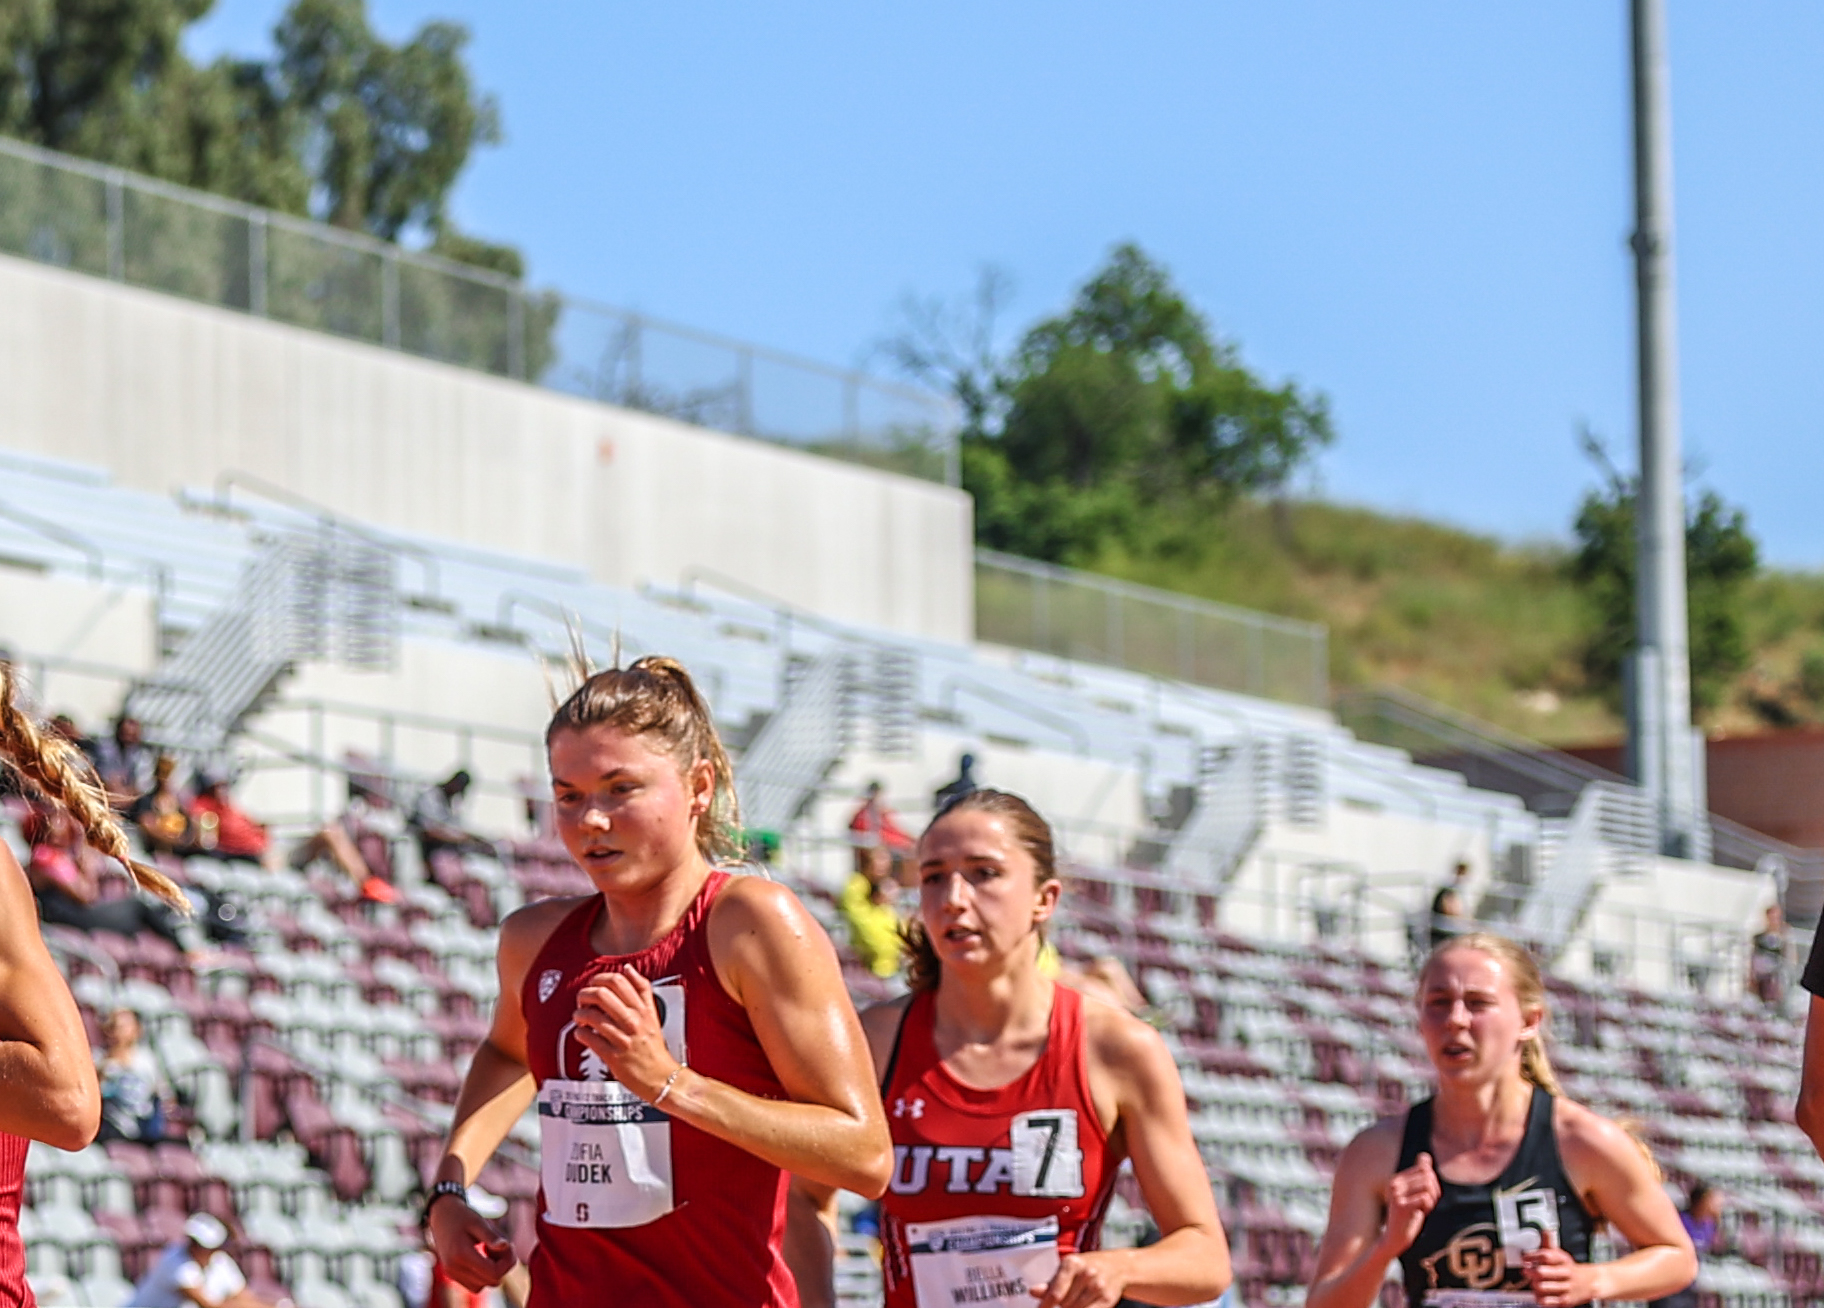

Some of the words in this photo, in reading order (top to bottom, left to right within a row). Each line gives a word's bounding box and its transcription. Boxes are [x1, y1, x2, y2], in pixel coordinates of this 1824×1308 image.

[888, 1144, 1084, 1195] UTA
[1027, 1117, 1061, 1189] 7
[1515, 1190, 1550, 1253] 5
